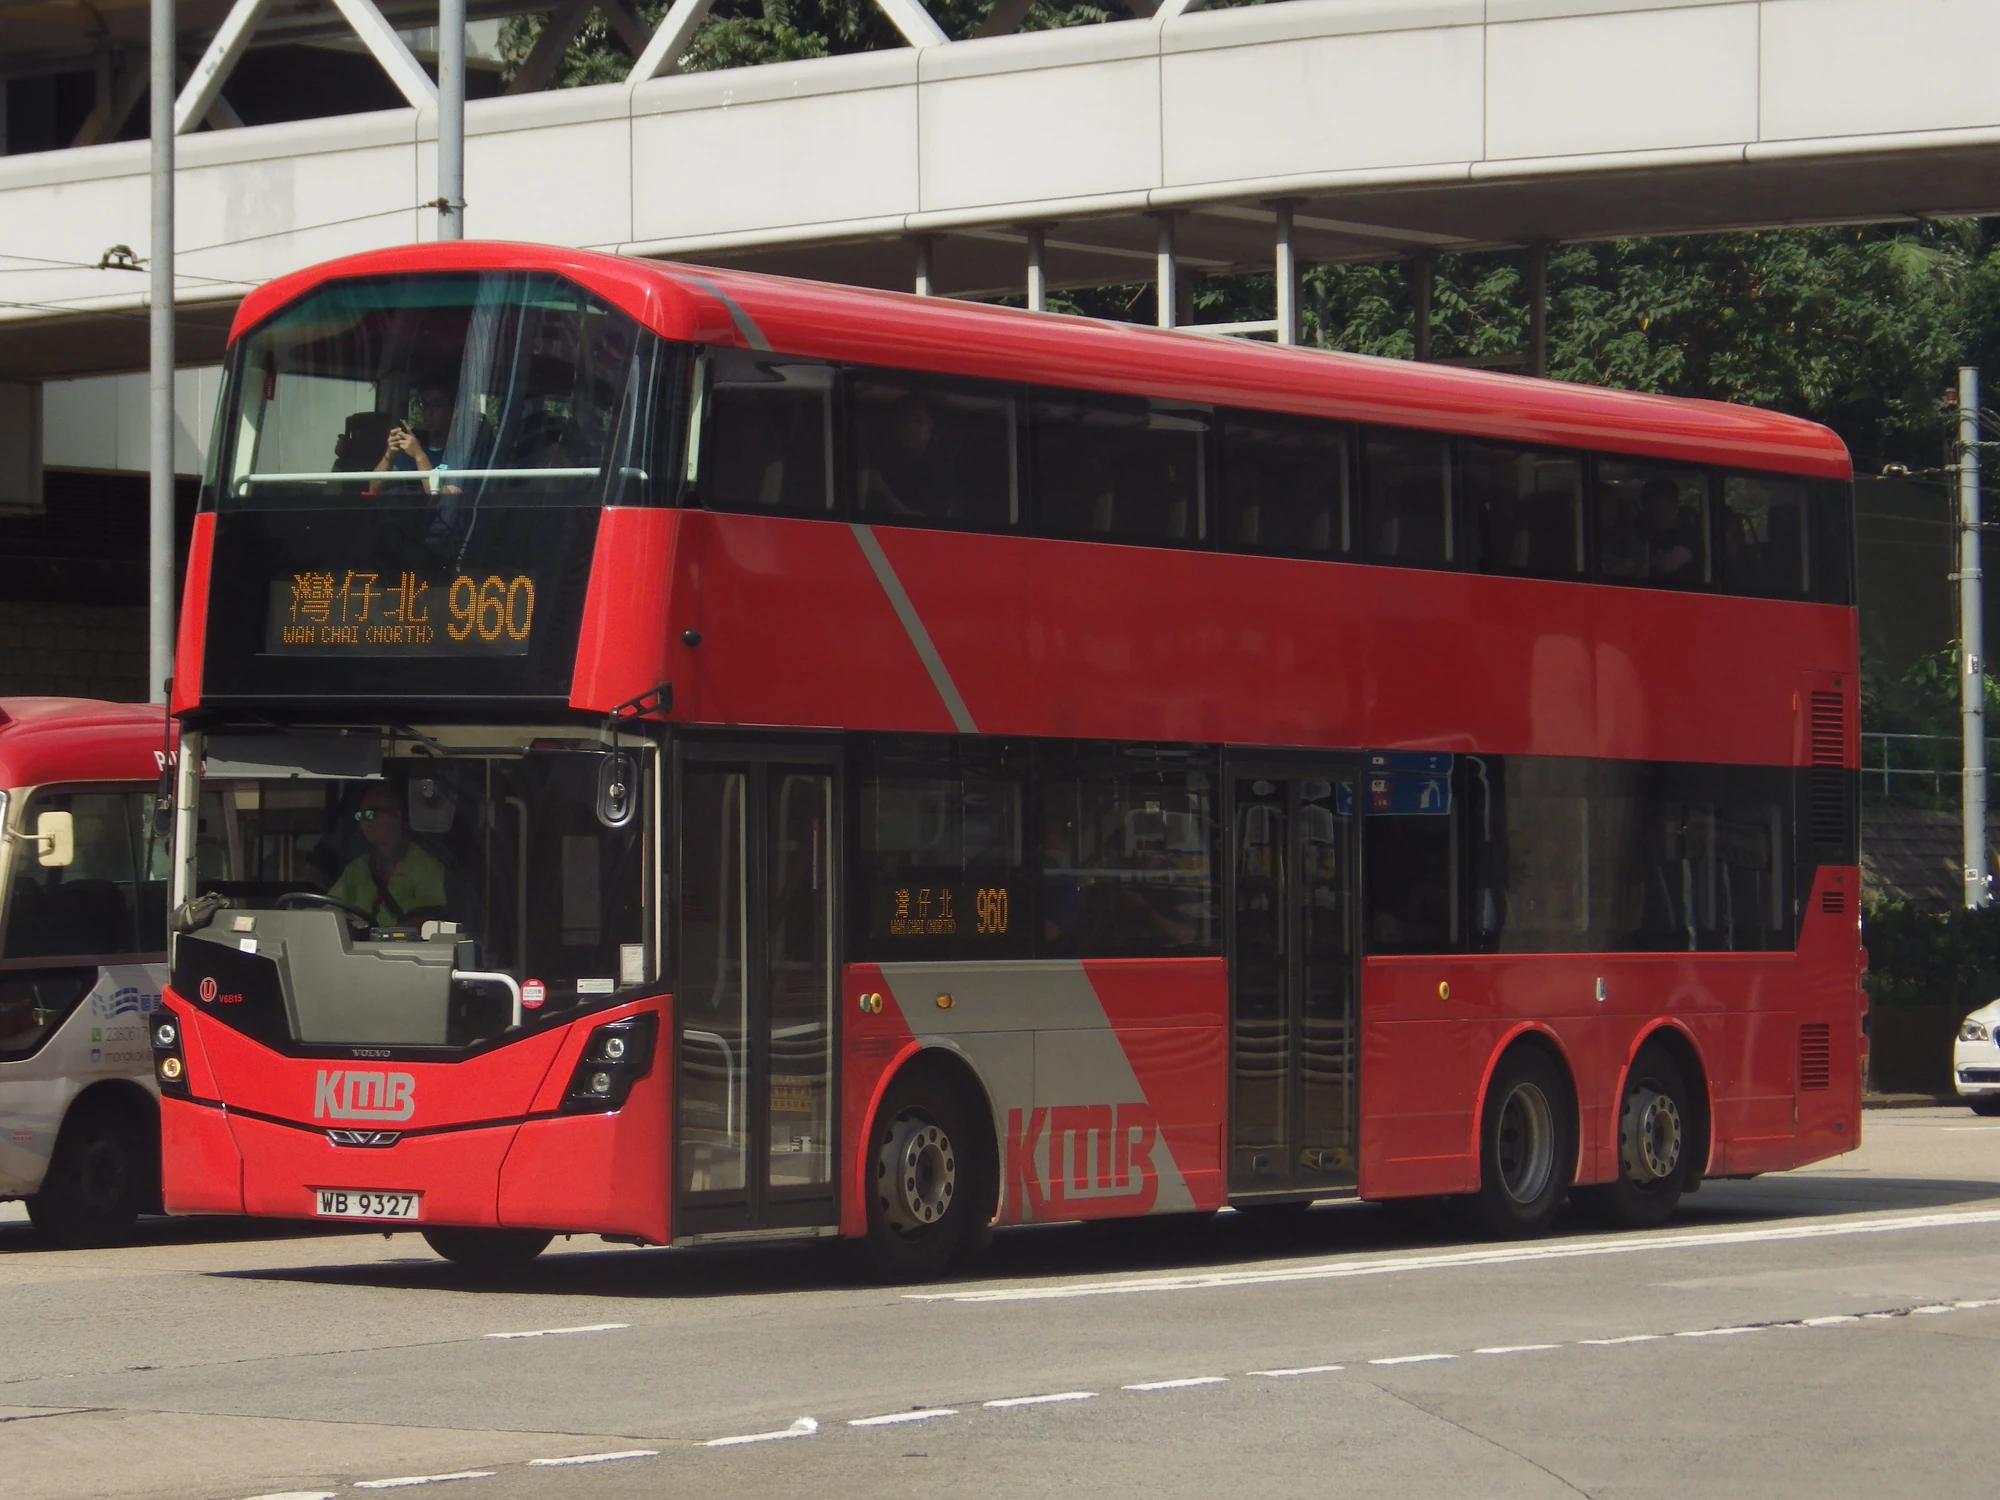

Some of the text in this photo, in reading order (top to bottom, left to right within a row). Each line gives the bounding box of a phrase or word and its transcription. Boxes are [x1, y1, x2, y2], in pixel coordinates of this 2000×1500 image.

[289, 569, 429, 622] 灣仔北
[447, 575, 535, 640] 960
[283, 625, 434, 643] WAN CHAI (NORTH)
[895, 888, 953, 918] 灣仔北
[976, 888, 1008, 934] 960
[218, 993, 243, 1003] V6B15
[351, 1049, 391, 1058] VOLVO
[321, 1192, 414, 1216] WB 9327
